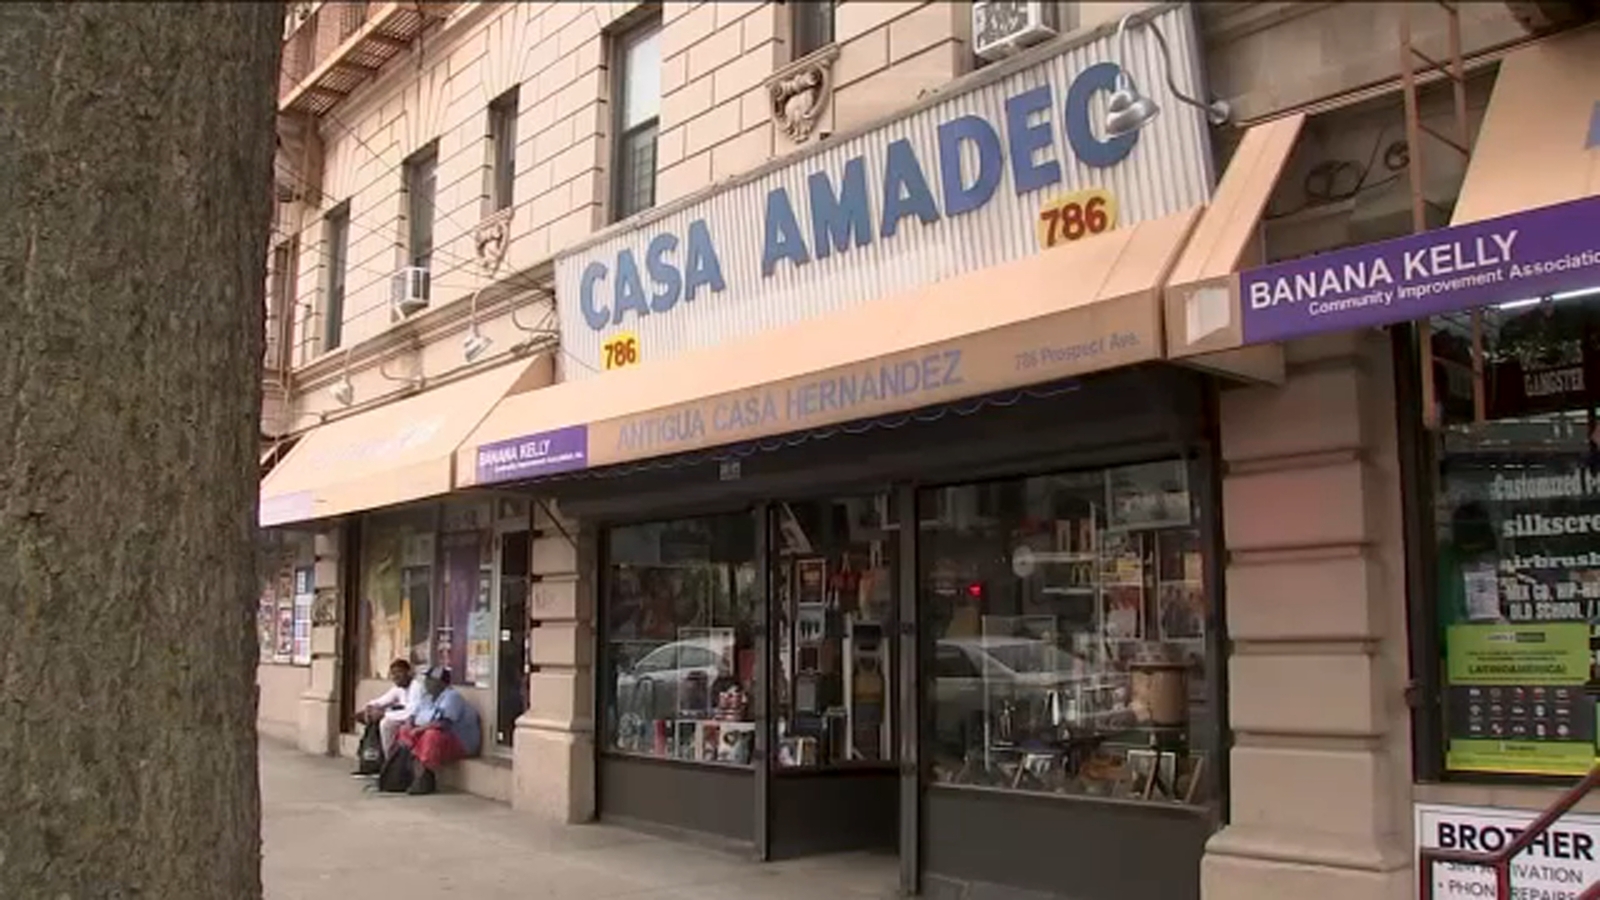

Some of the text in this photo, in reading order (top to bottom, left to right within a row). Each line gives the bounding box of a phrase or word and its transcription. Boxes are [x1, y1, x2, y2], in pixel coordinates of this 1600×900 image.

[1041, 196, 1107, 247] 786
[580, 219, 726, 331] CASA
[1250, 229, 1518, 309] BANANA KELLY
[1309, 289, 1393, 315] Community
[1398, 268, 1503, 299] Improvement
[604, 338, 637, 370] 786
[1040, 337, 1104, 362] Prospect
[617, 350, 962, 451] ANTIGUA CASA HERNANDEZ
[480, 446, 518, 467] BANANA
